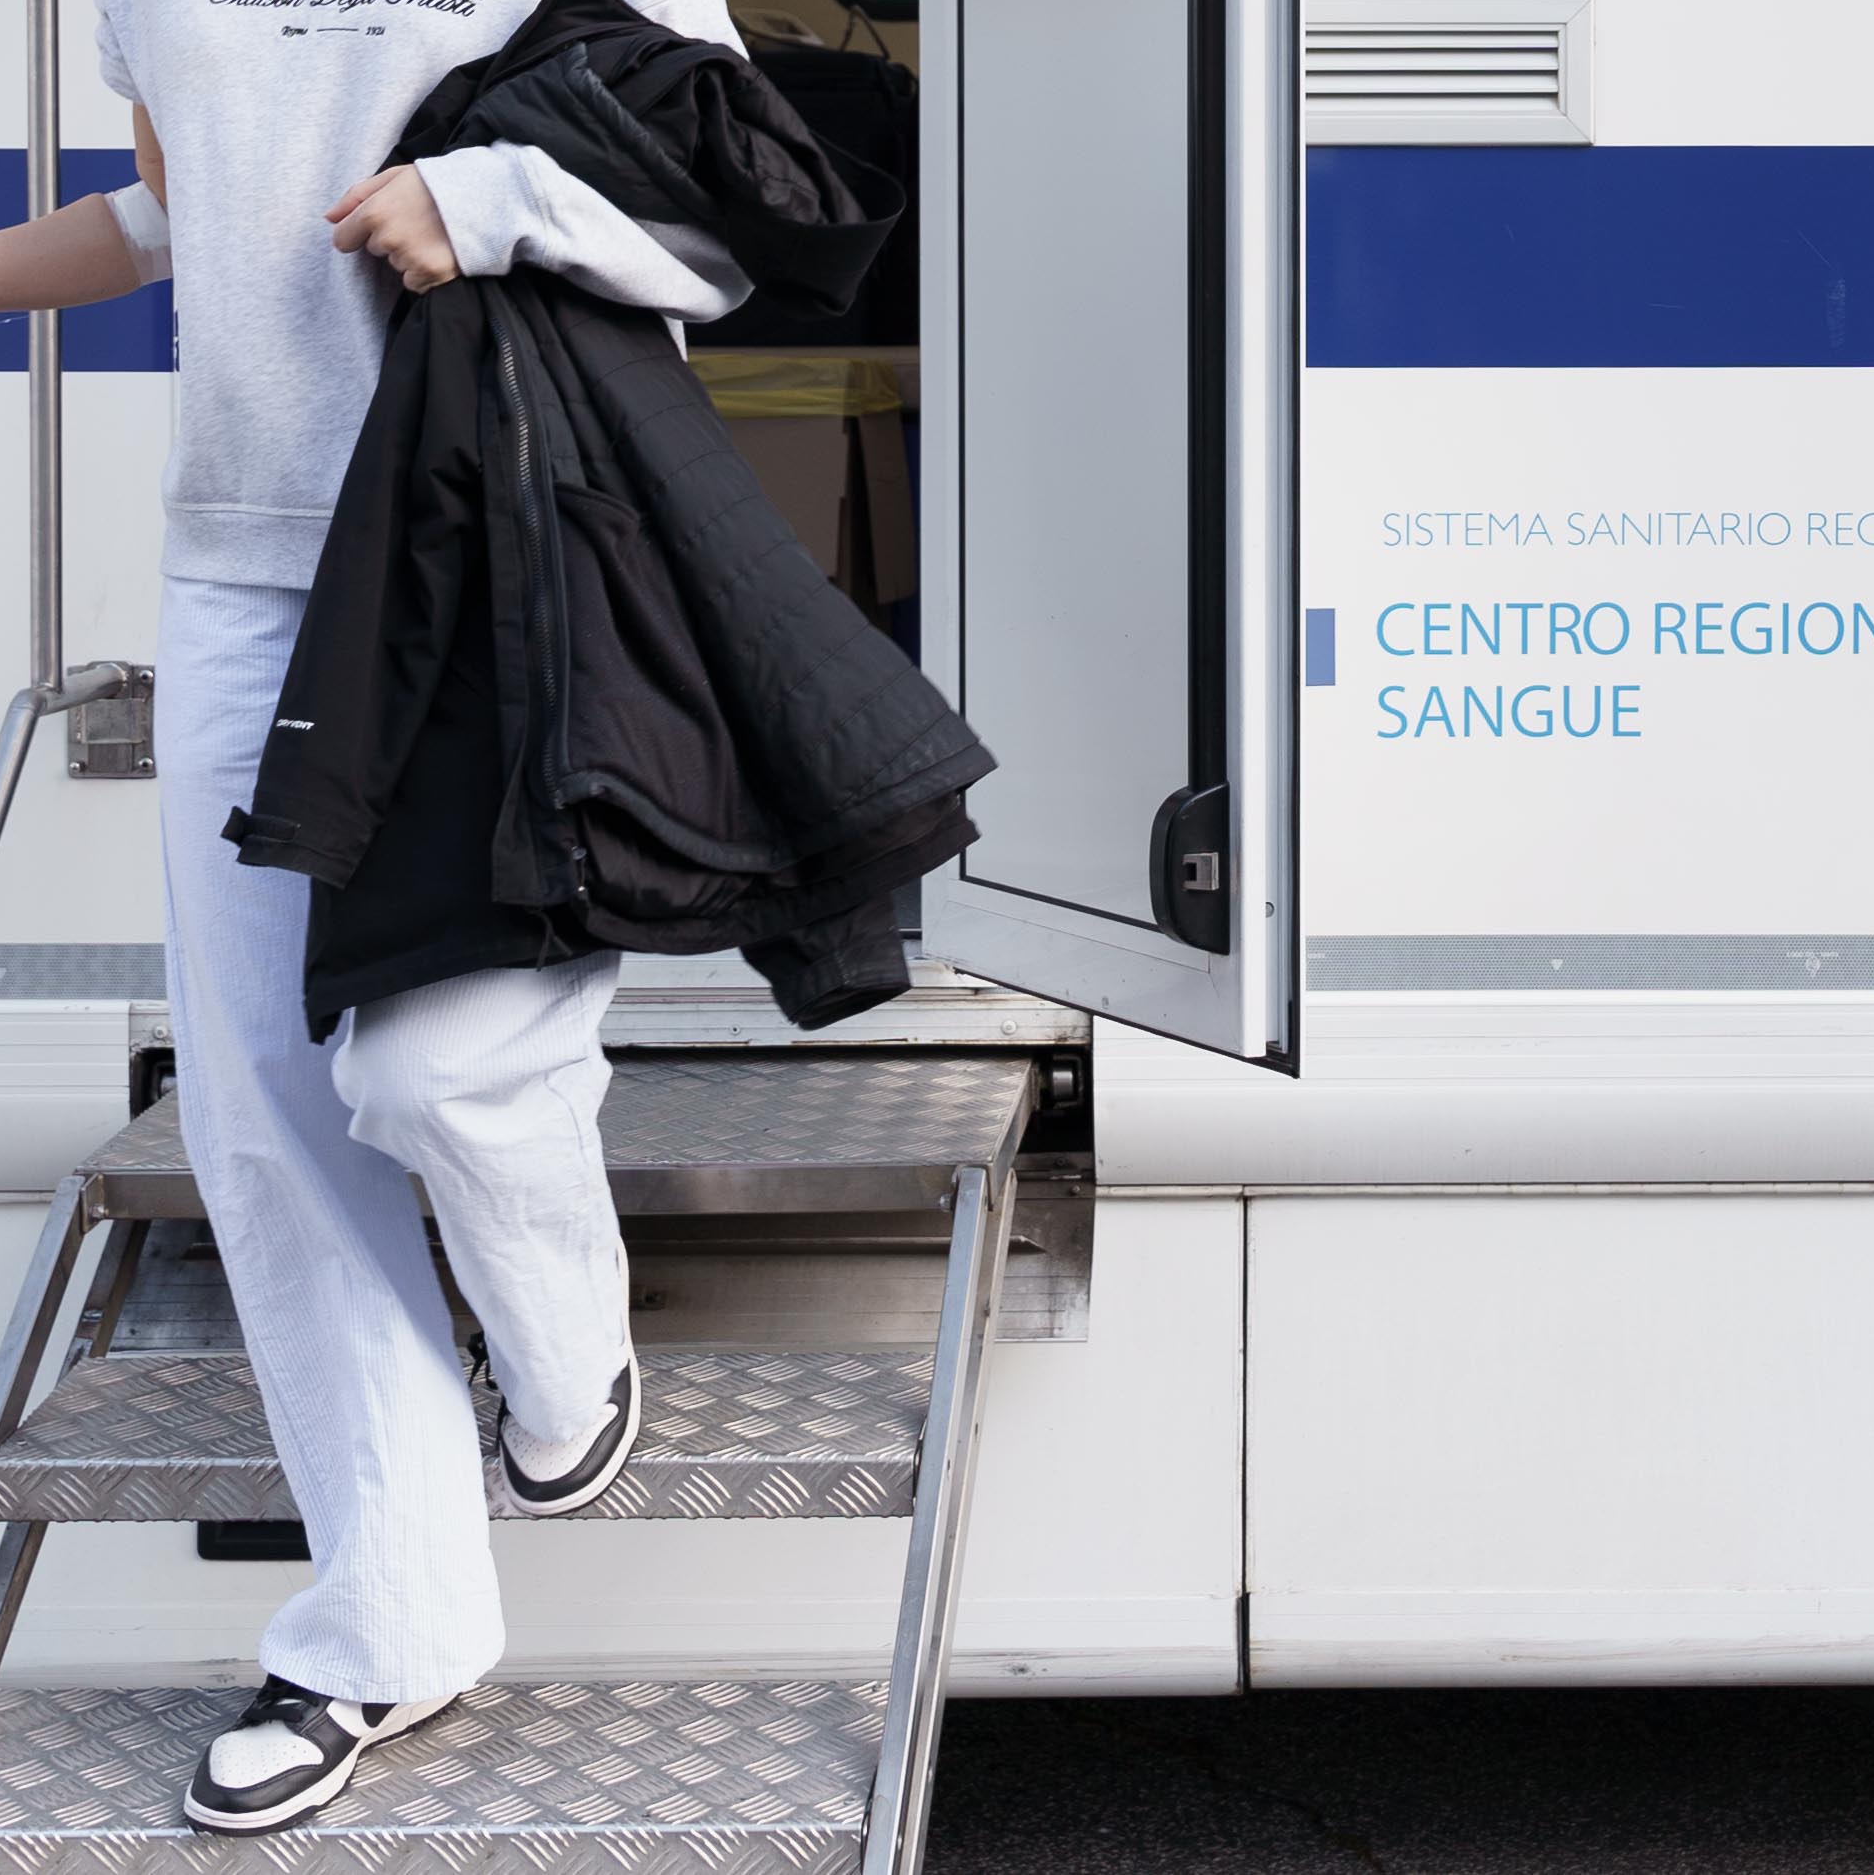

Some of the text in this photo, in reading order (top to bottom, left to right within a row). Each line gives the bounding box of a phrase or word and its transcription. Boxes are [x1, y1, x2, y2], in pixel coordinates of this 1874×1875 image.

[1382, 511, 1554, 548] SISTEMA
[1567, 511, 1794, 548] SANITARIO
[1376, 602, 1631, 658] CENTRO
[1377, 685, 1643, 741] SANGUE
